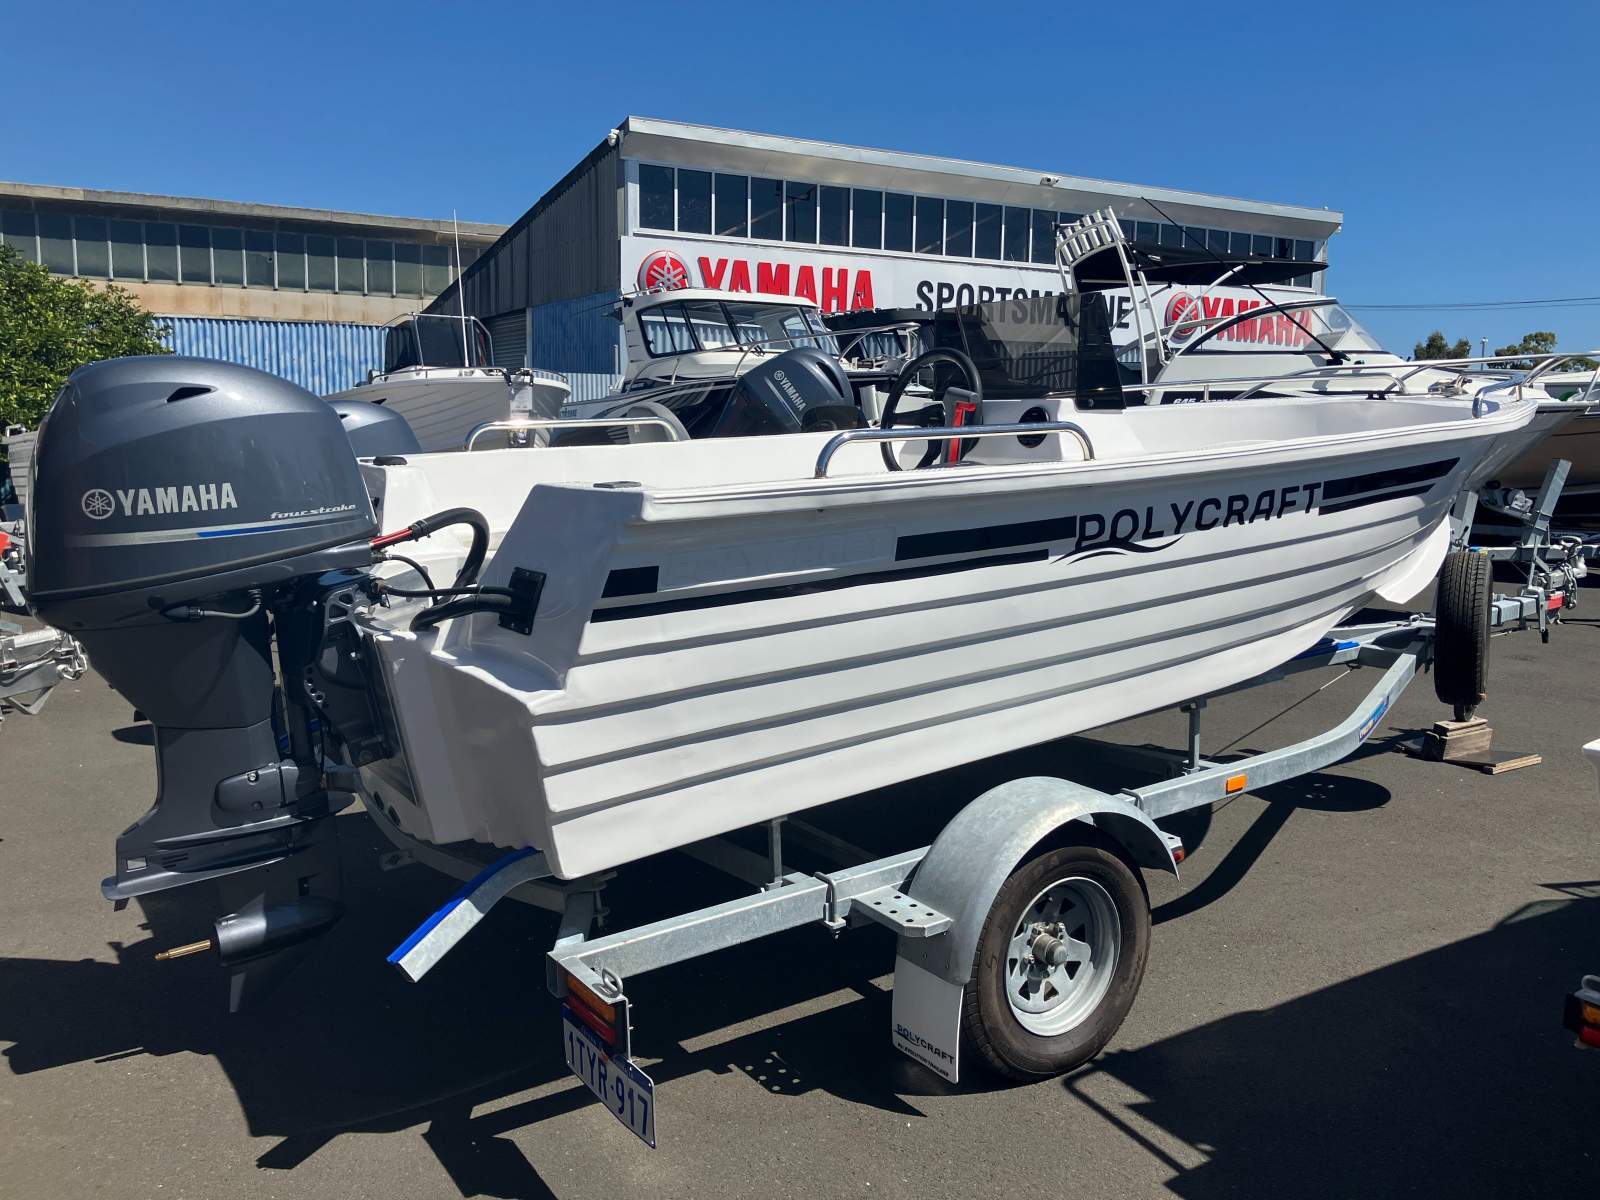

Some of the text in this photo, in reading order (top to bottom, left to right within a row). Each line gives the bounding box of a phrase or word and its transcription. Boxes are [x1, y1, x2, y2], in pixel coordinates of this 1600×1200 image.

[698, 257, 874, 313] YAMAHA
[916, 280, 1131, 328] SPORTSMANE
[781, 377, 807, 411] YAMAHA
[116, 482, 238, 516] YAMAHA
[1075, 482, 1322, 550] POLYCRAFT
[897, 1024, 954, 1064] POLYCRAFT
